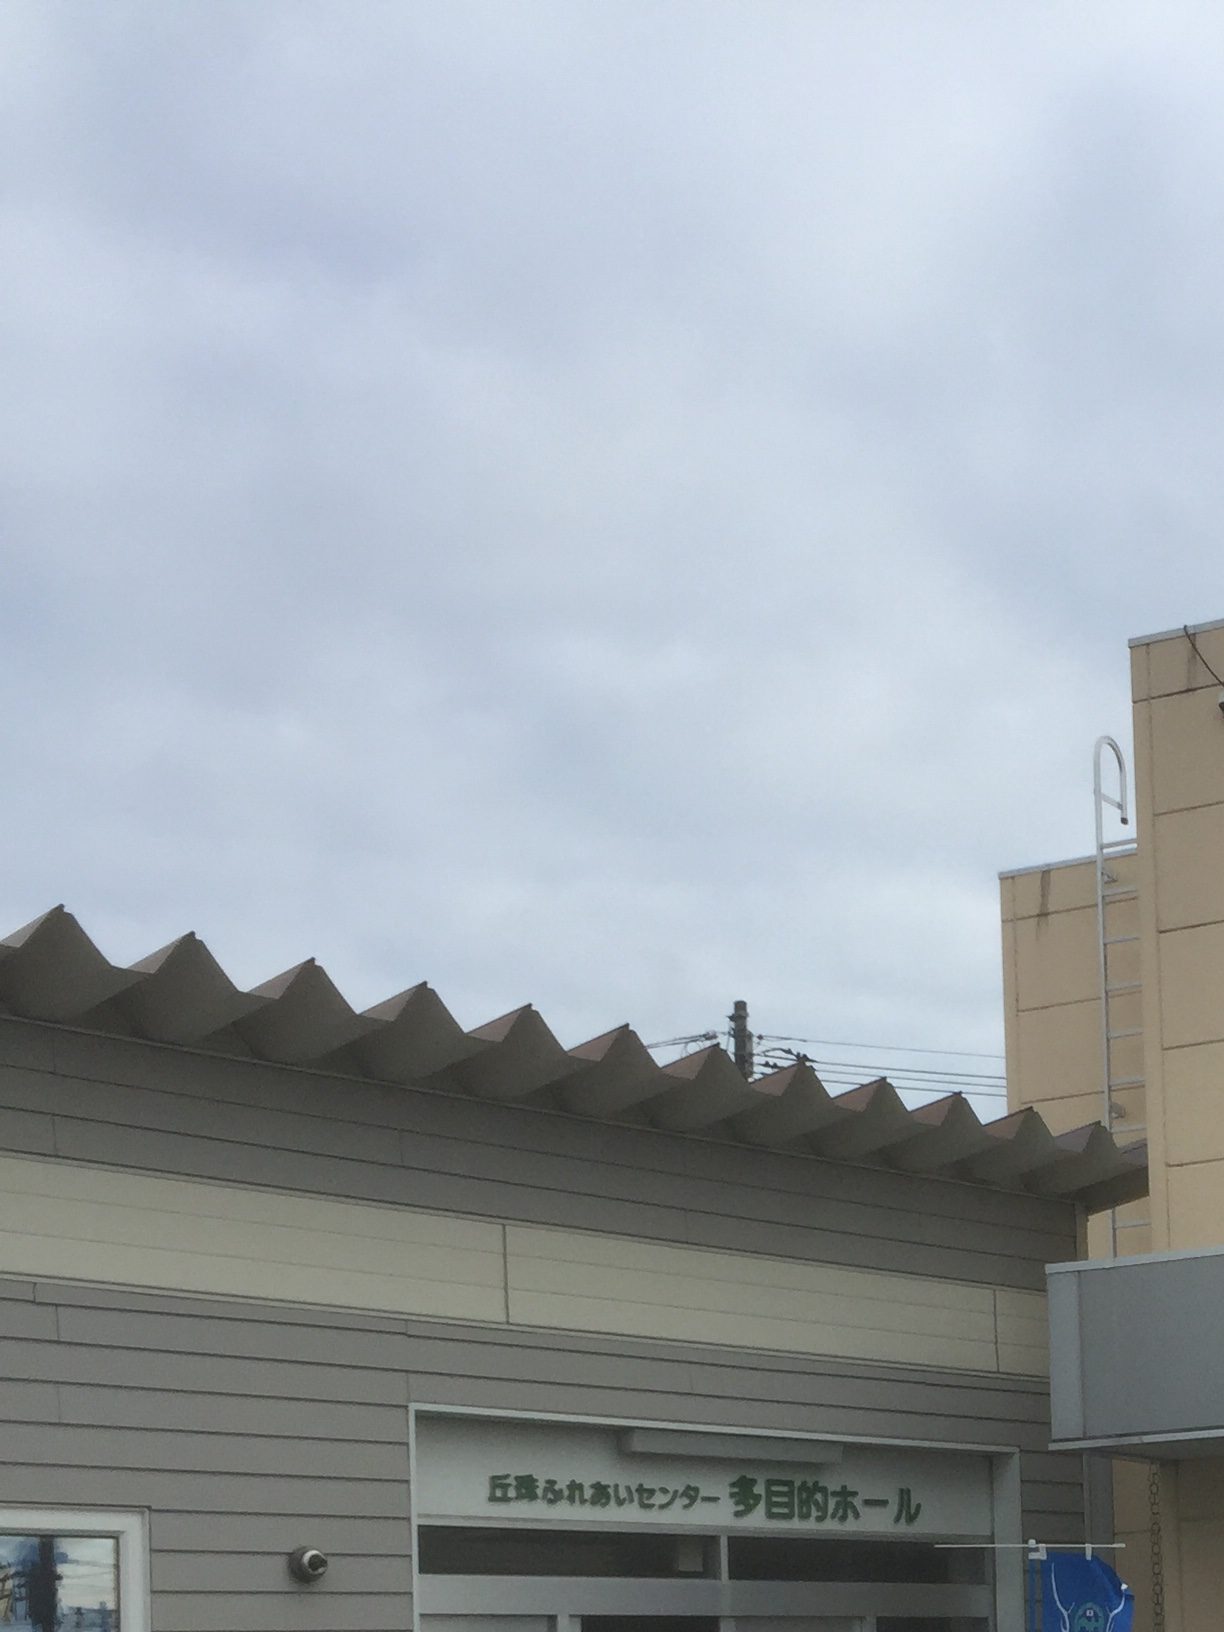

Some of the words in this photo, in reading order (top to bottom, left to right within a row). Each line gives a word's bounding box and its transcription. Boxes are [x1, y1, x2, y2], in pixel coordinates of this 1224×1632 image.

[729, 1475, 922, 1525] 多目的ホール
